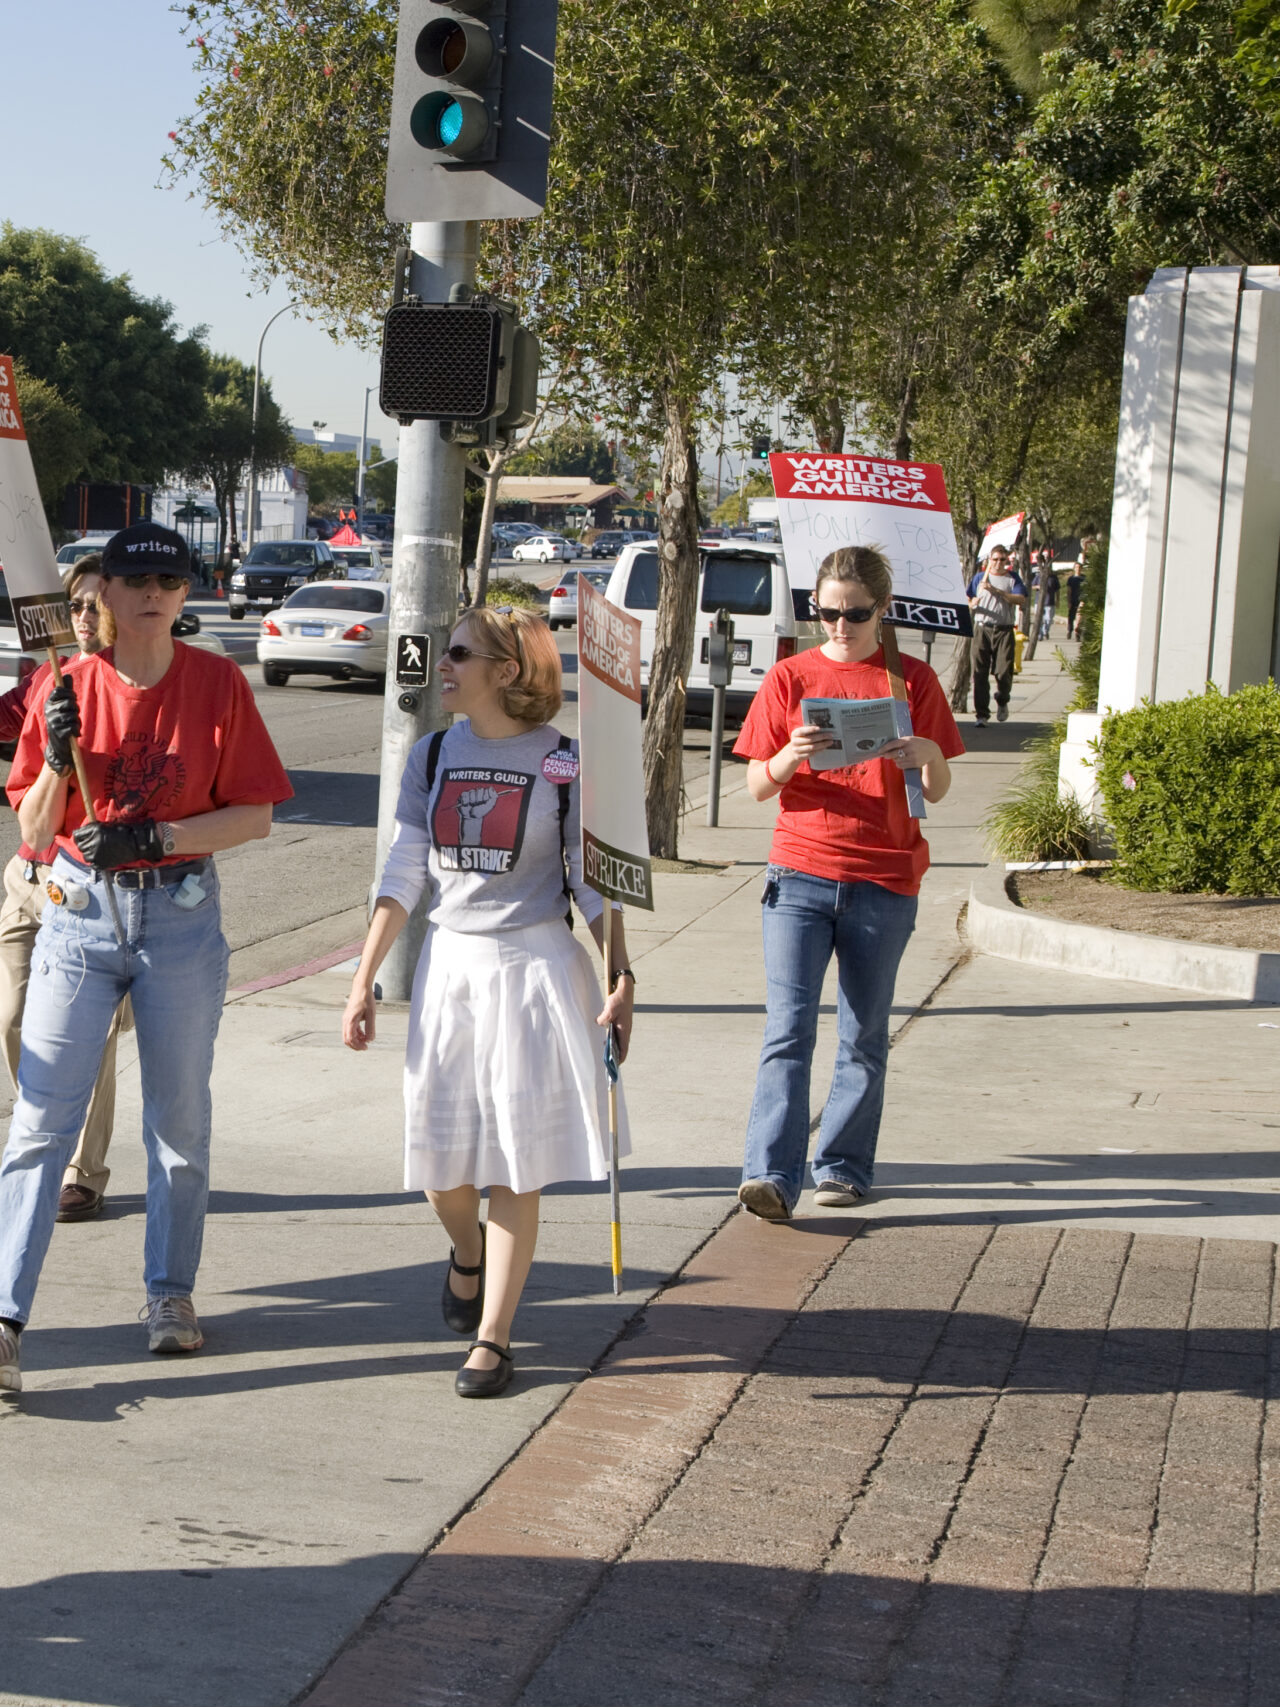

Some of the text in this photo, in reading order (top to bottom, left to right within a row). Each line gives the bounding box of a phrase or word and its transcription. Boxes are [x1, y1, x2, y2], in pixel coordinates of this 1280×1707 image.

[0, 391, 11, 408] OF
[787, 457, 926, 480] WRITERS
[793, 469, 922, 491] GUILD OF
[789, 481, 935, 506] AMERICA
[787, 501, 881, 542] HONK
[894, 521, 956, 555] FOR
[126, 540, 178, 556] writer
[20, 601, 71, 641] STRIKE
[583, 588, 633, 646] WRITERS
[583, 614, 631, 665] GUILD OF
[581, 635, 635, 691] AMERICA
[543, 765, 577, 777] DOWN
[544, 758, 579, 771] PENCILS
[449, 770, 528, 785] WRITERS GUILD
[440, 847, 513, 872] ON STRIKE
[586, 841, 647, 899] STRIKE
